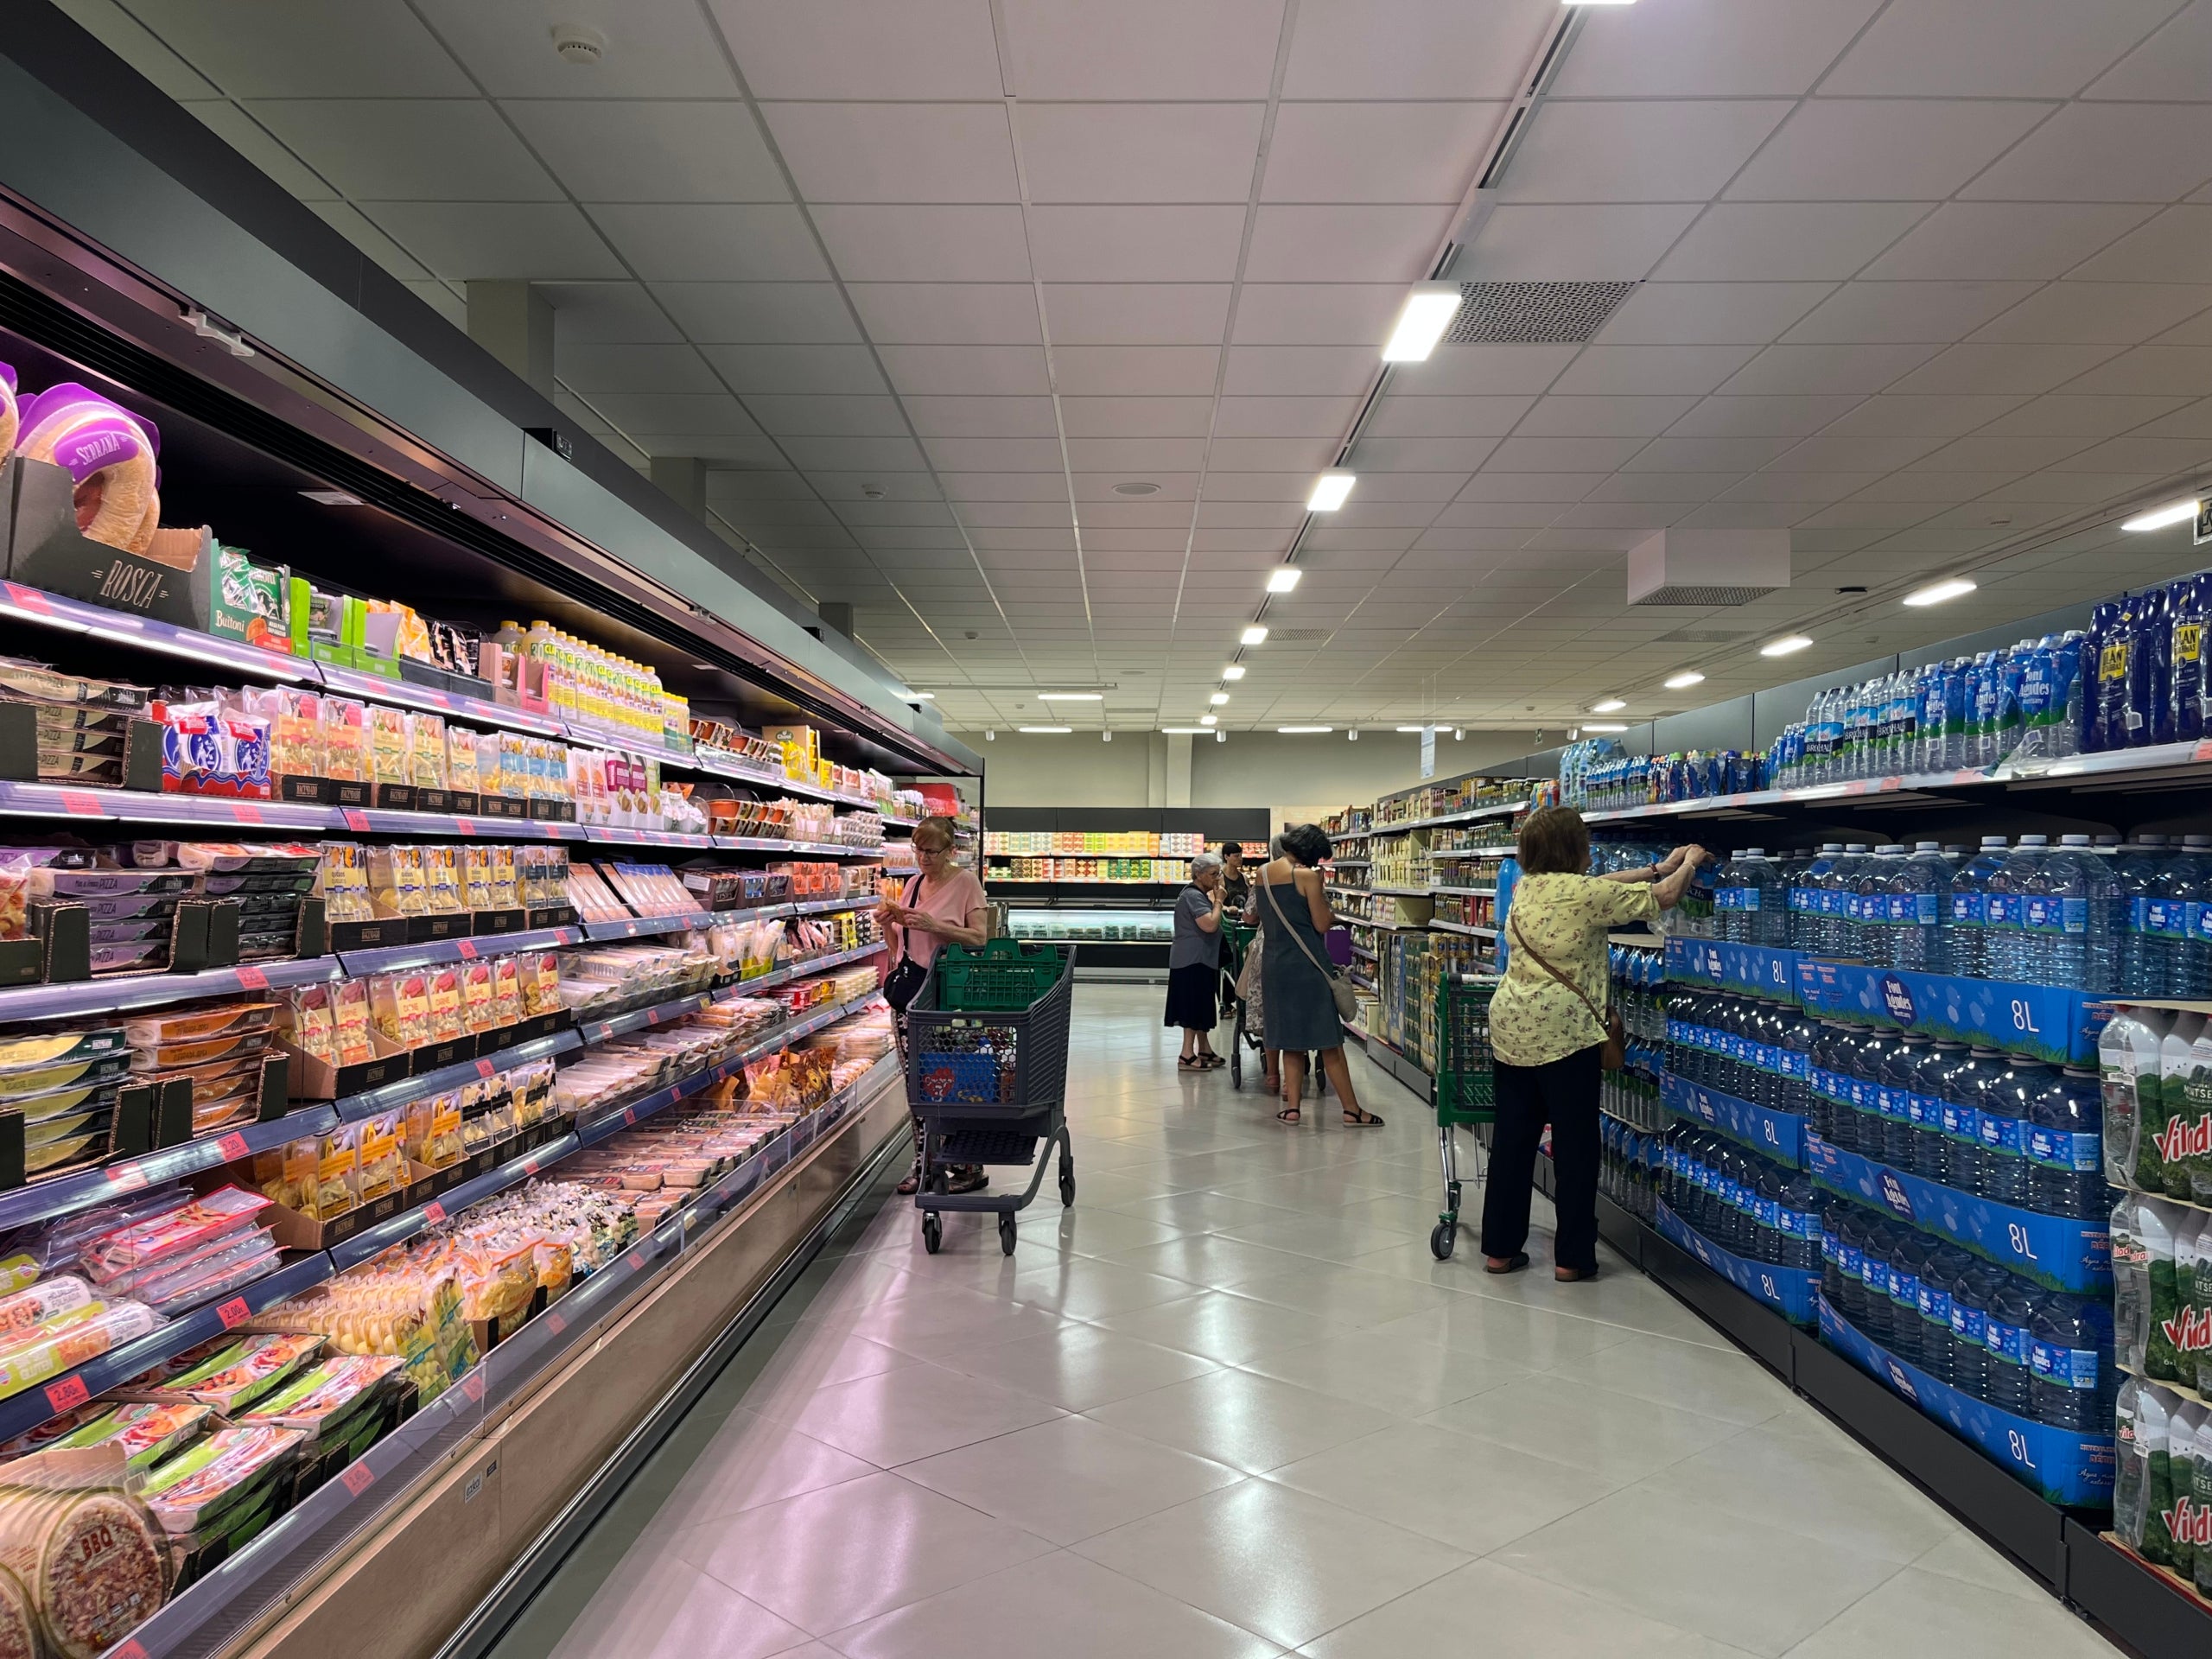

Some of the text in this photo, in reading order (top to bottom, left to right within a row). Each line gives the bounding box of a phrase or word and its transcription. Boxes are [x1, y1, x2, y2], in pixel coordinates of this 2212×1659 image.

[76, 433, 121, 466] SERRANA
[99, 560, 164, 609] ROSCA
[215, 609, 245, 632] Buitoni
[99, 878, 118, 889] PIZZA
[97, 904, 117, 914] PIZZA
[97, 930, 115, 941] PIZZA
[95, 952, 114, 963] PIZZA
[1772, 961, 1786, 984] 8L
[2011, 999, 2040, 1033] 8L
[1764, 1119, 1779, 1146] 8L
[2008, 1223, 2037, 1260] 8L
[1760, 1274, 1780, 1301] 8L
[2008, 1429, 2036, 1469] 8L
[81, 1525, 114, 1560] BBQ
